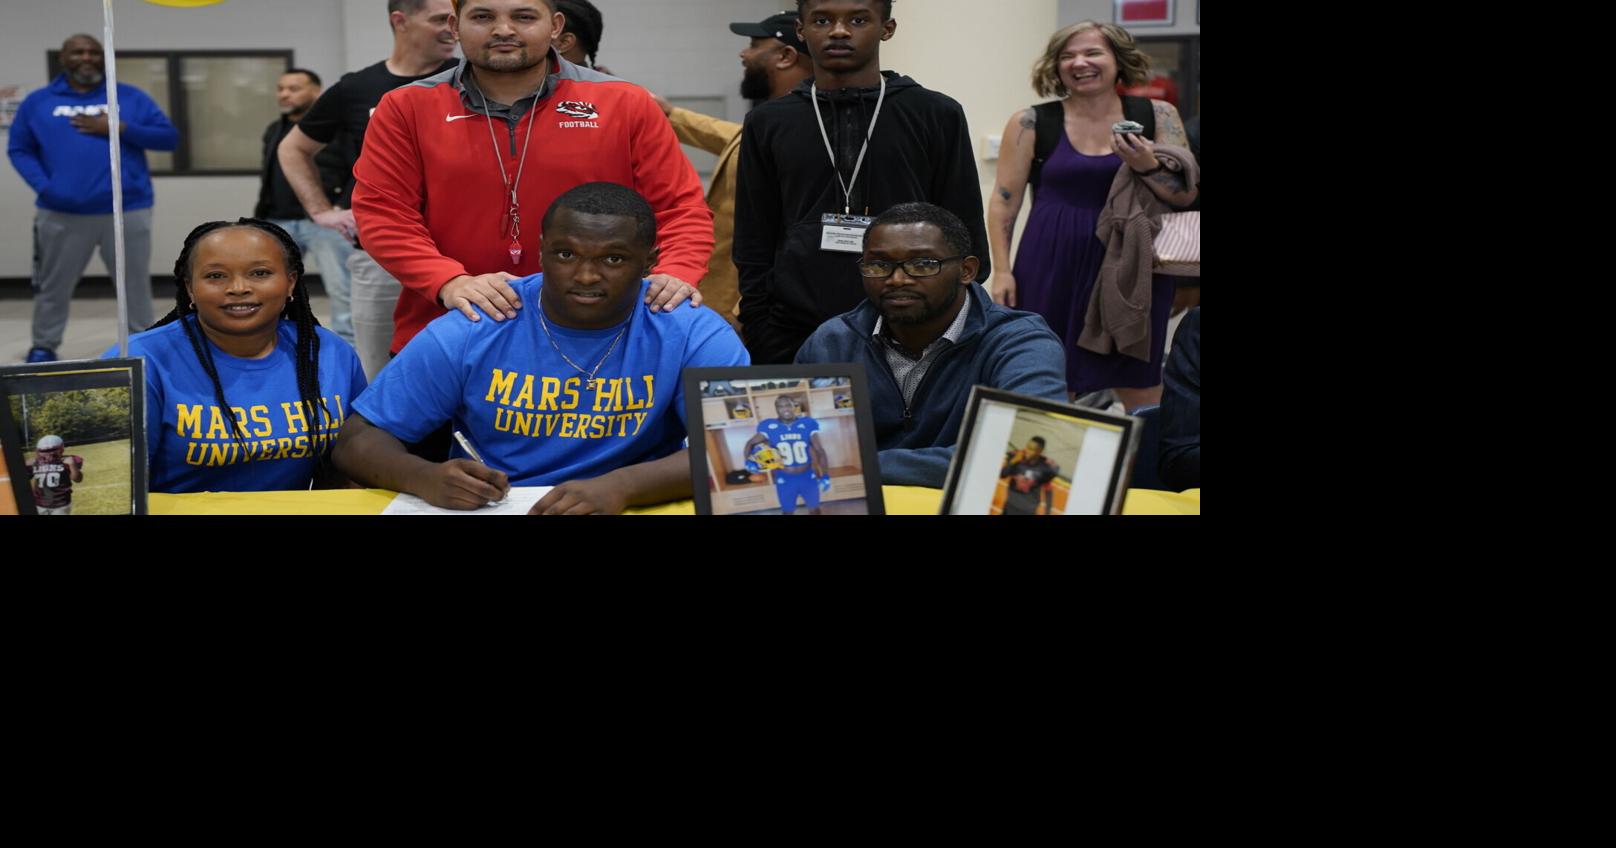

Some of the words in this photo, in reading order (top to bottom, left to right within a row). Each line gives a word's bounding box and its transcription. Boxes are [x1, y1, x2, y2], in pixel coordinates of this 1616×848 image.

[559, 121, 599, 129] FOOTBALL
[485, 368, 581, 411] MARS
[176, 403, 273, 440] MARS
[494, 407, 648, 439] UNIVERSITY
[776, 441, 808, 466] 90
[34, 472, 61, 488] 70
